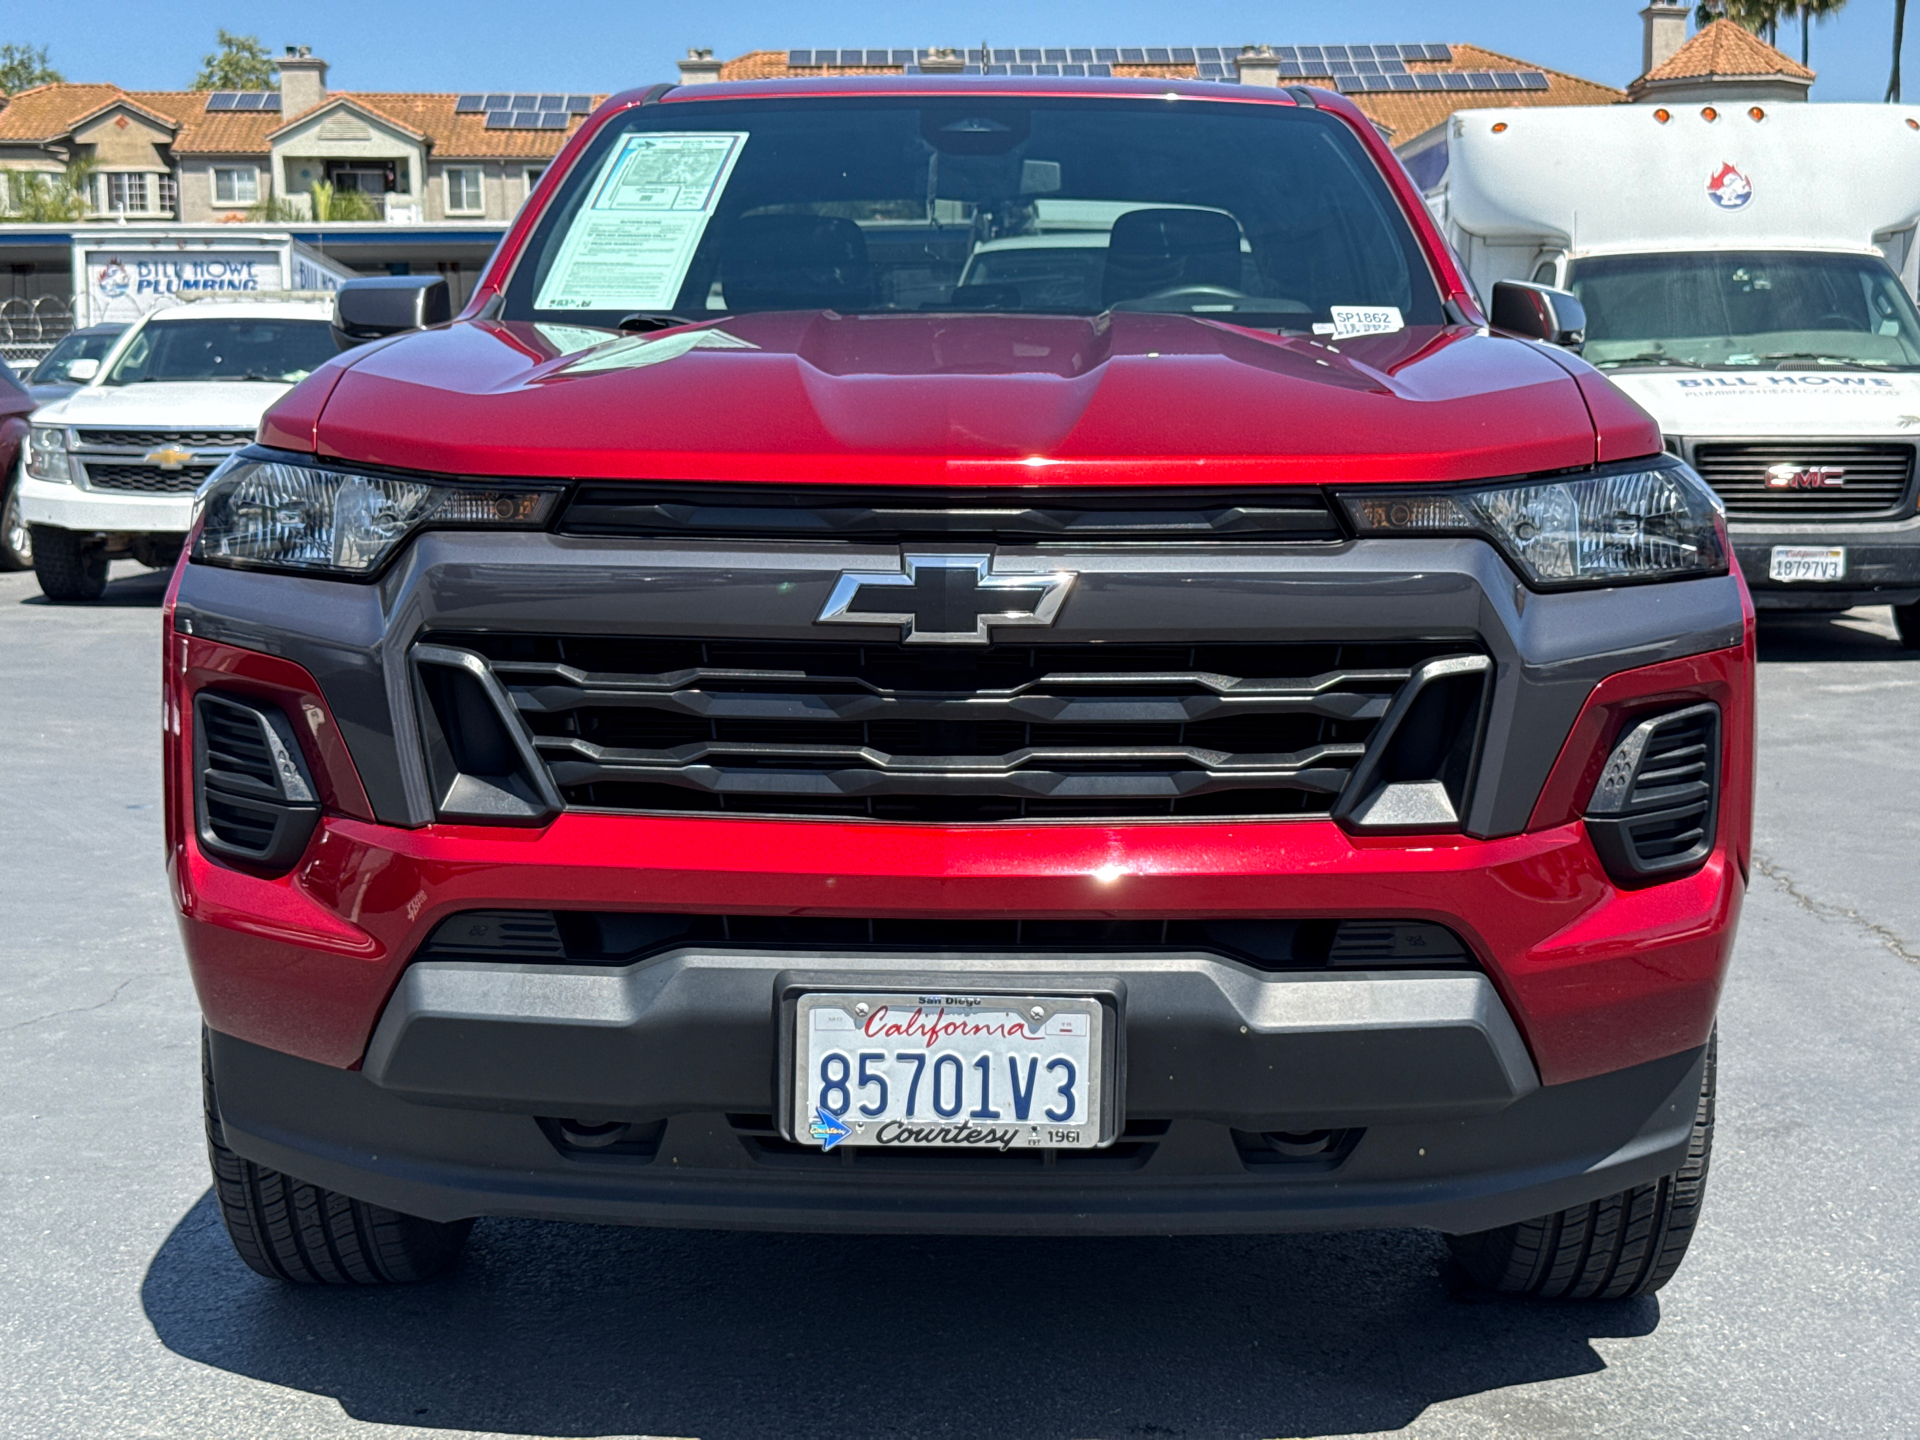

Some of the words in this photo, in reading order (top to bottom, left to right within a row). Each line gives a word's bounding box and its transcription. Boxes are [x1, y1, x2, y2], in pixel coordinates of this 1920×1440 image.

[1336, 312, 1392, 324] SP1862
[1676, 377, 1758, 387] BILL
[1766, 376, 1893, 387] HOWE
[1764, 465, 1846, 488] GMC
[1774, 560, 1839, 579] 18797V3
[918, 997, 941, 1005] San
[945, 997, 982, 1007] Diego
[864, 1005, 1046, 1048] California
[820, 1052, 1077, 1122] 85701V3
[876, 1119, 1021, 1152] Courtesy
[1047, 1130, 1081, 1144] 1961
